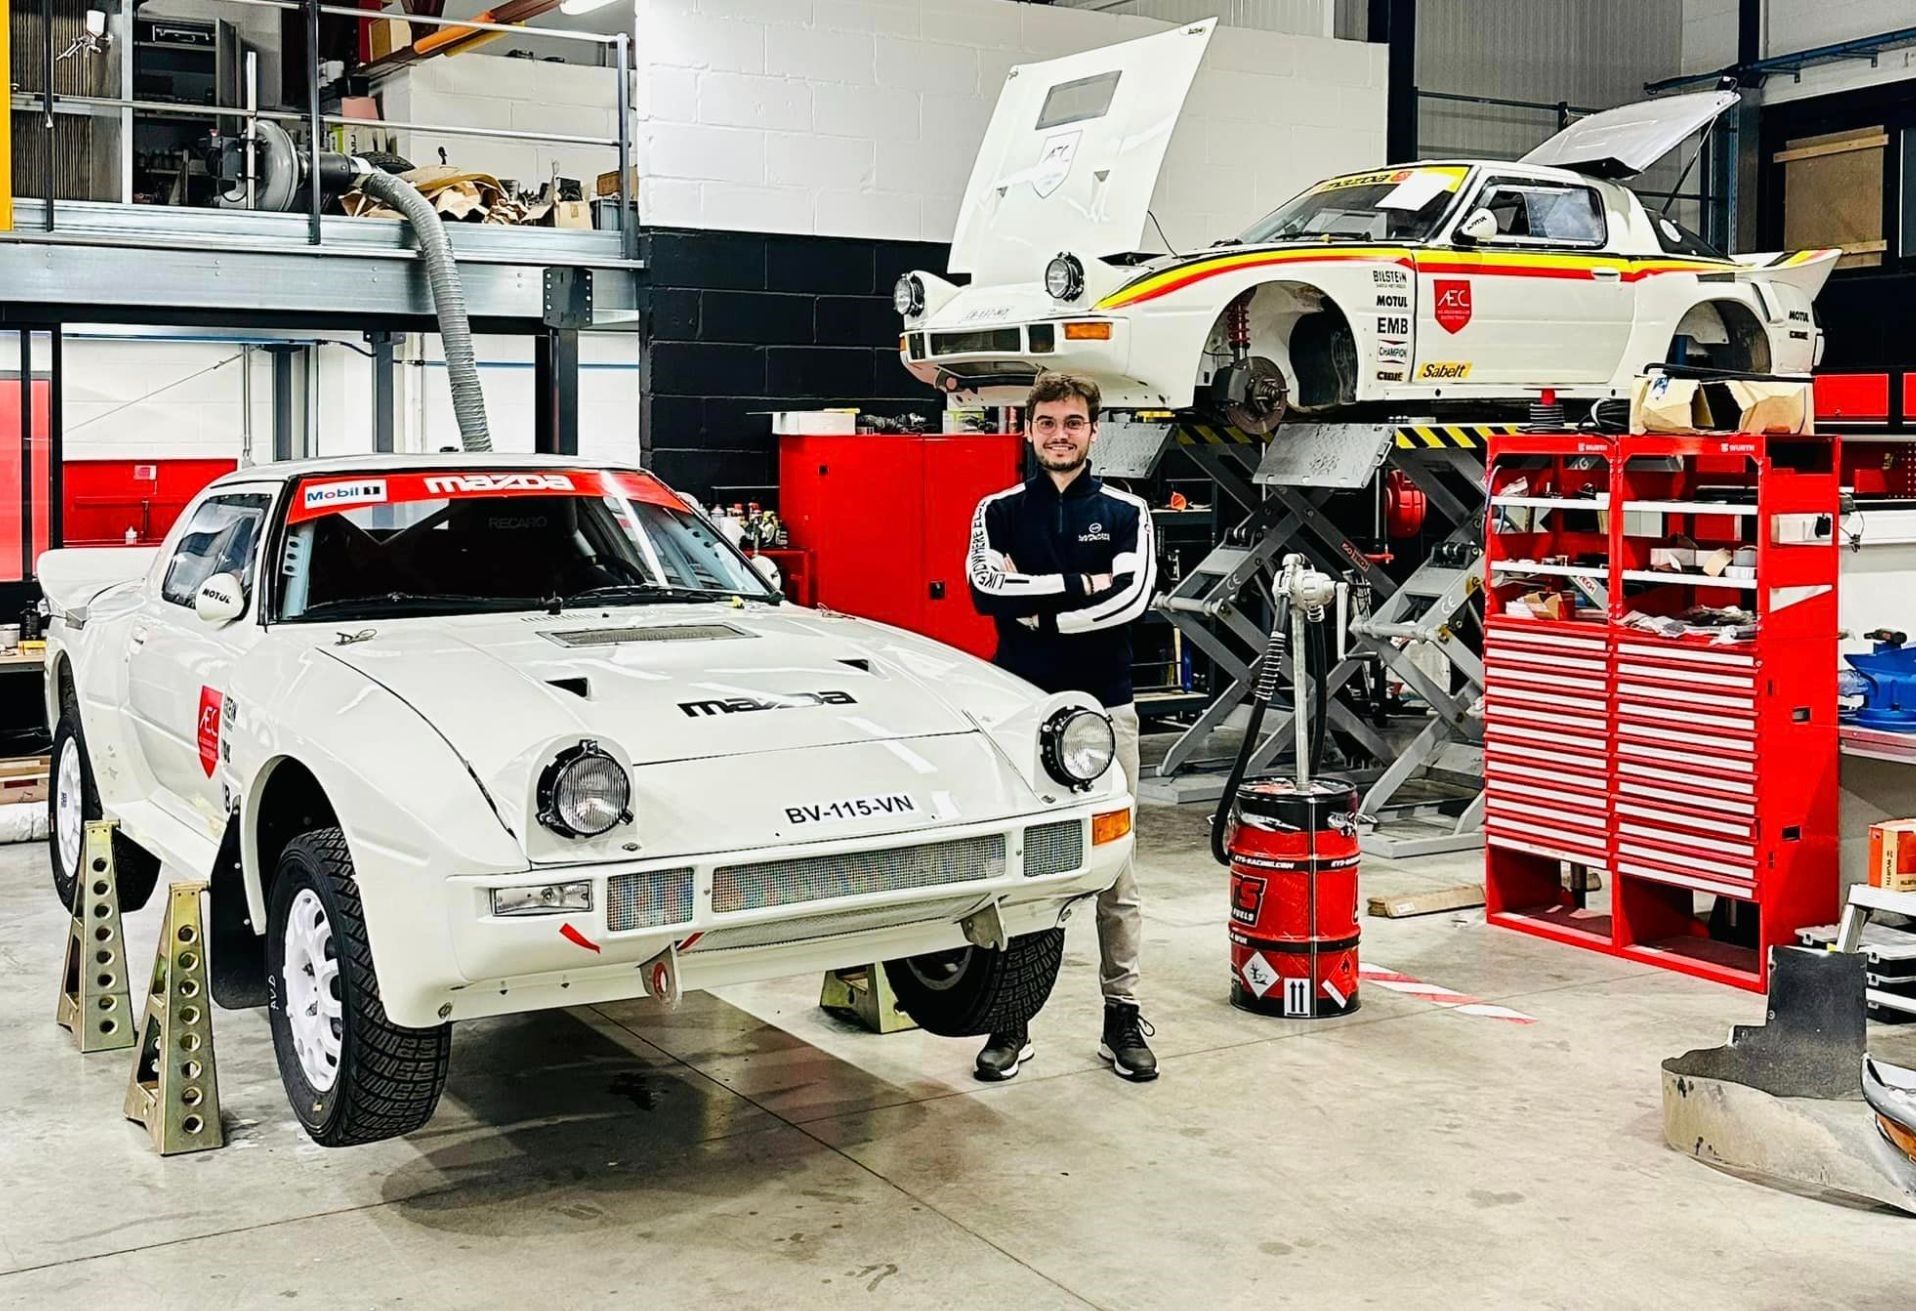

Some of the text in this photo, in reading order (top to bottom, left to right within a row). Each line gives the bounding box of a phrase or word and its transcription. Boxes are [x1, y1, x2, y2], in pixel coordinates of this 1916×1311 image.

[1373, 270, 1407, 283] BILSTEIN
[1376, 294, 1408, 308] MOTUL
[1788, 310, 1809, 323] MOTUL
[1377, 316, 1408, 334] EMB
[1422, 363, 1466, 378] Sabelt
[424, 474, 576, 494] mazda
[307, 487, 358, 502] Mobil
[488, 515, 549, 529] RECARO
[202, 588, 231, 604] MOTUL
[785, 794, 915, 824] BV-115-VN
